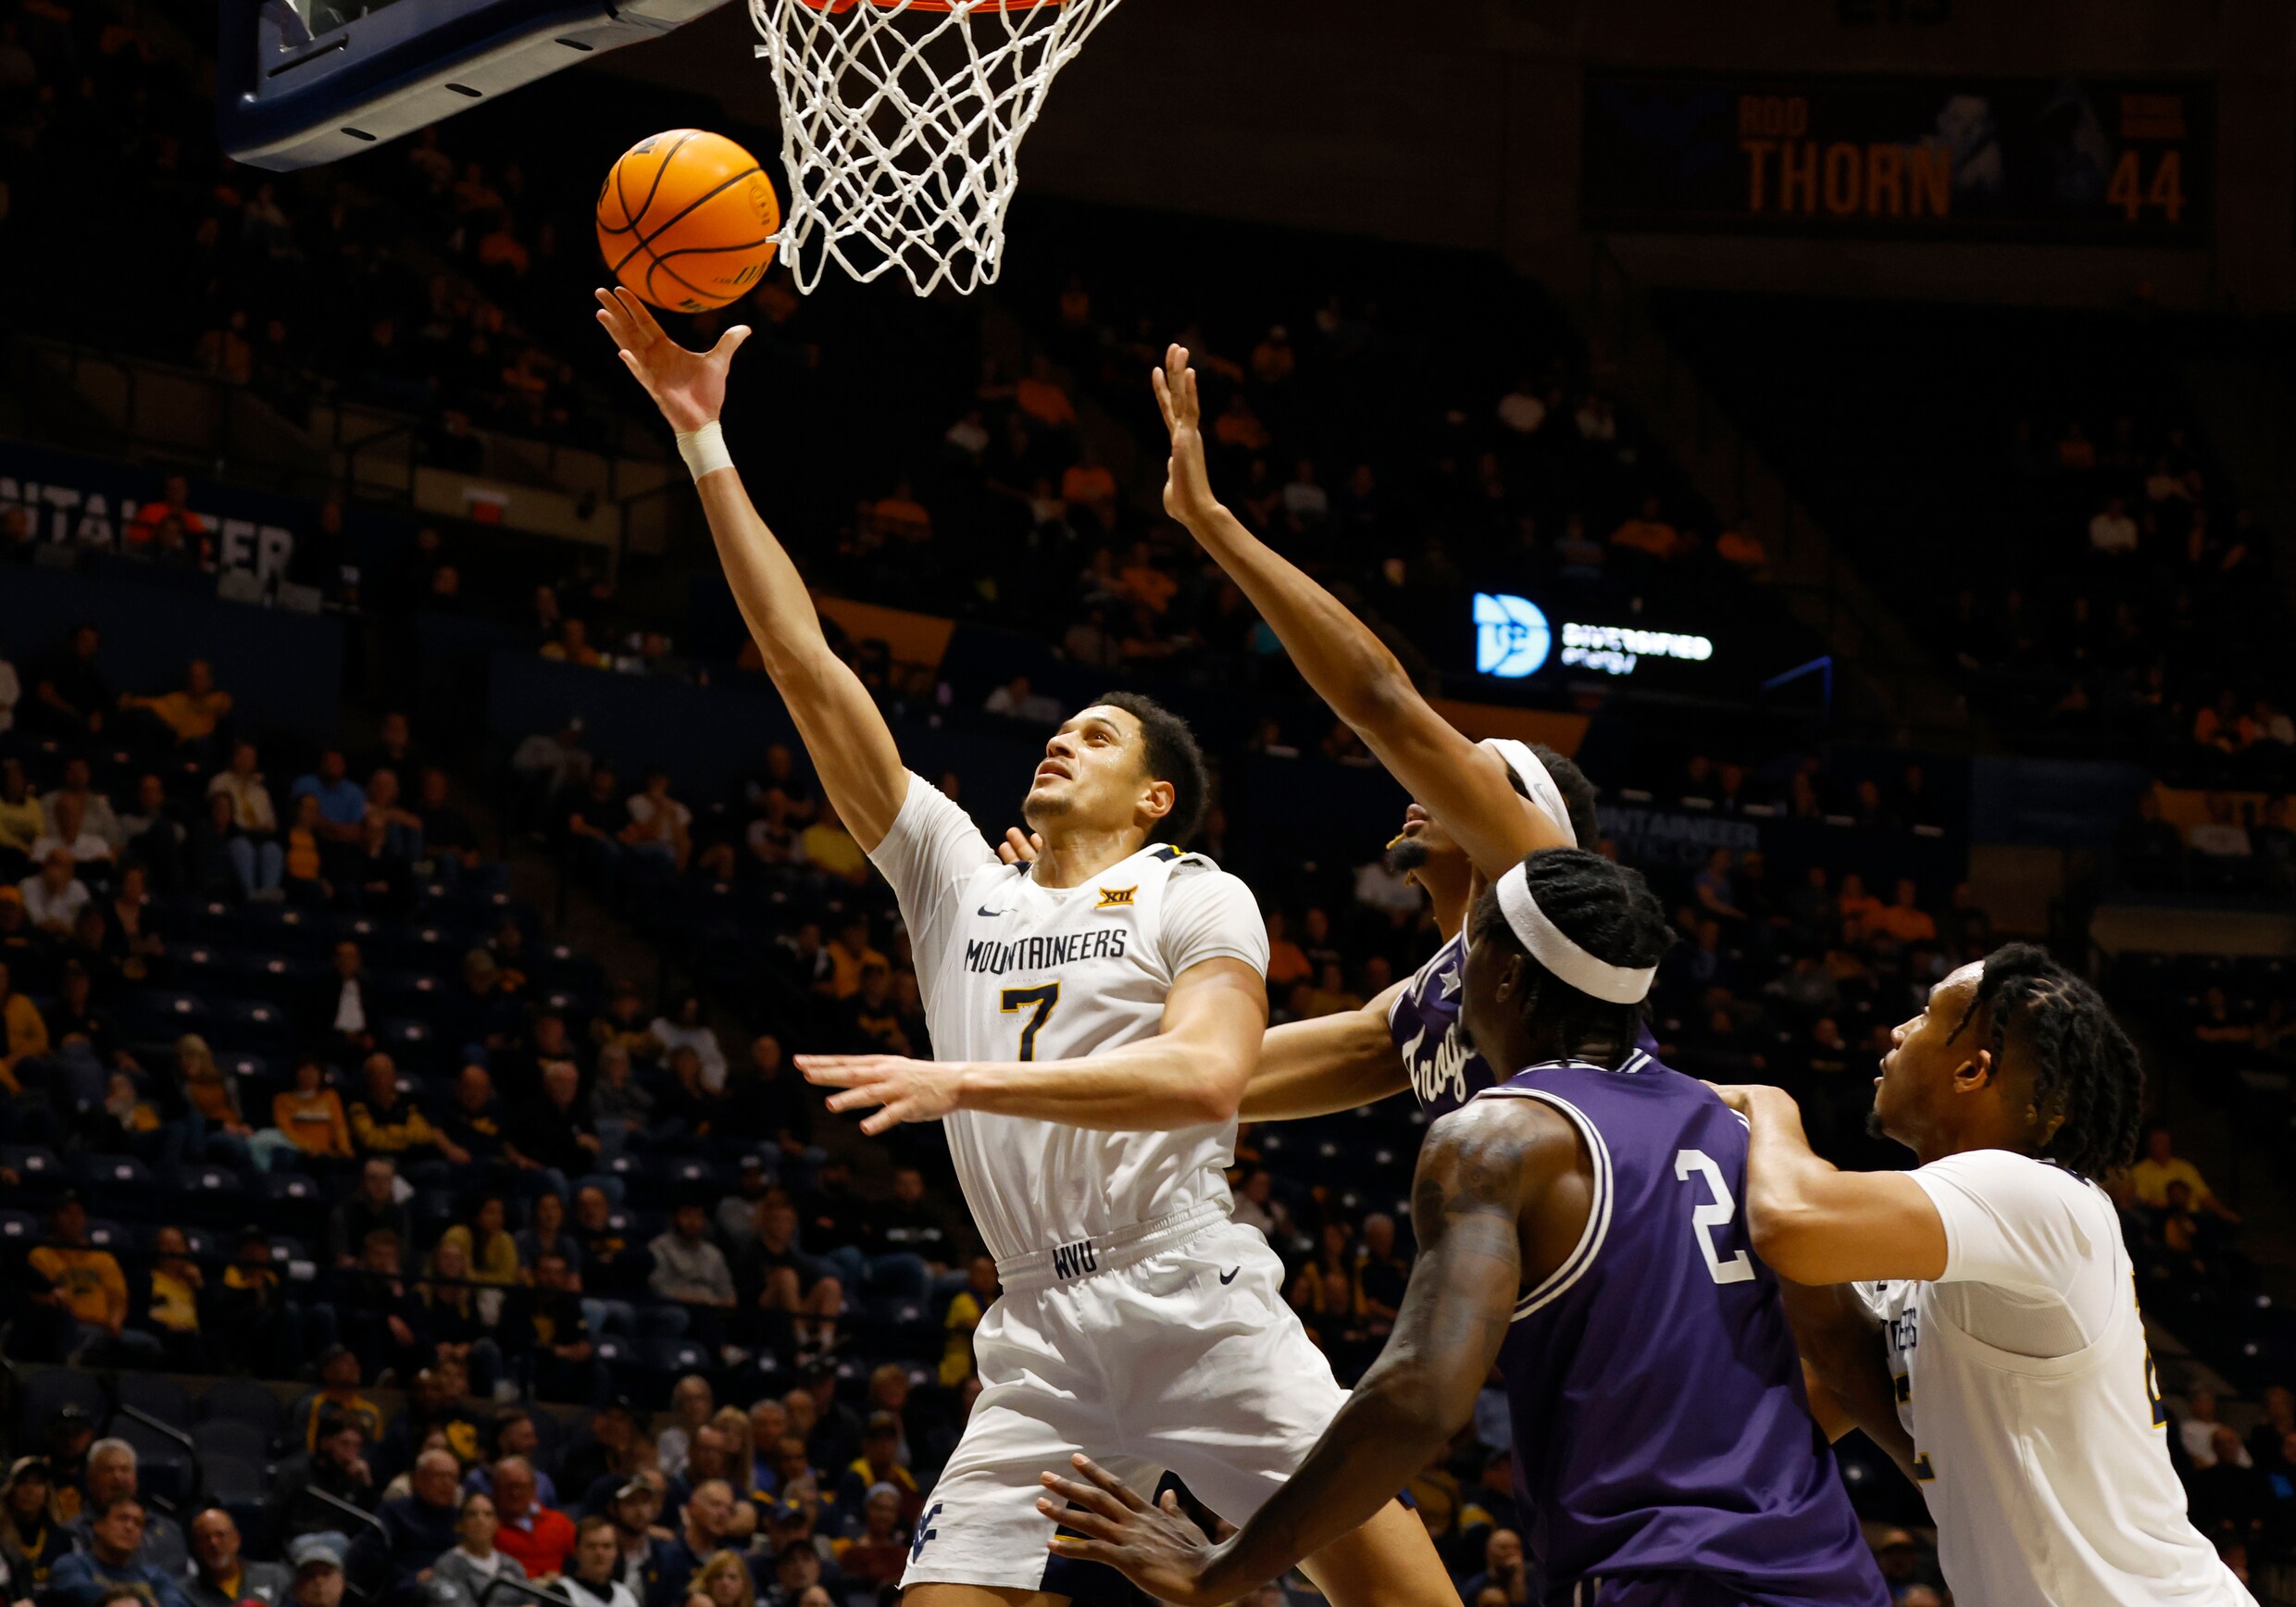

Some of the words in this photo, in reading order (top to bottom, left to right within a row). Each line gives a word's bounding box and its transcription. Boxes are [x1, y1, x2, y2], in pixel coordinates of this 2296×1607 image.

[1740, 140, 1953, 218] THORN
[2106, 148, 2188, 223] 44
[964, 928, 1128, 975] MOUNTAINEERS
[1000, 980, 1061, 1062] 7
[1403, 1021, 1477, 1102] Frog
[1674, 1149, 1756, 1285] 2
[1052, 1240, 1097, 1280] WVU
